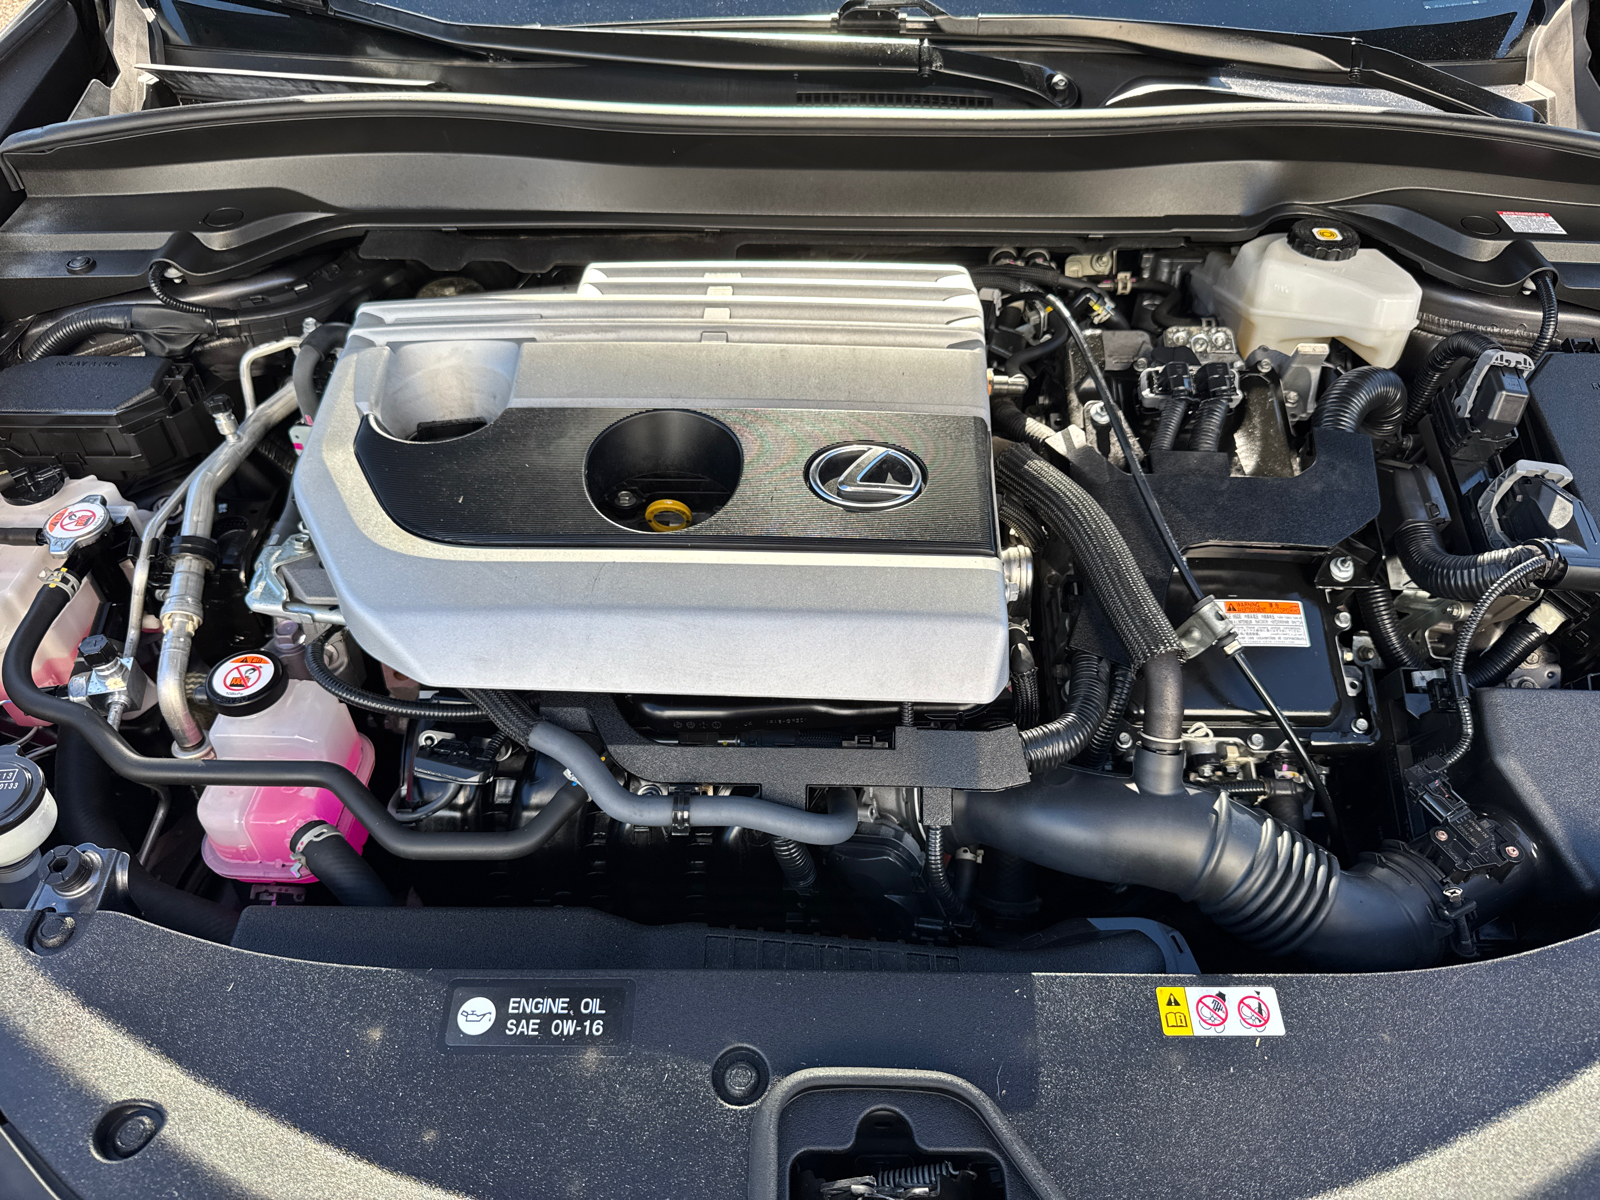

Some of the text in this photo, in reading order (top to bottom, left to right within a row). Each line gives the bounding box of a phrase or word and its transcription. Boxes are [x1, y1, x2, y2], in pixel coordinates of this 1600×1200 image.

[508, 998, 606, 1014] ENGINE OIL
[505, 1019, 604, 1036] SAE 0W-16
